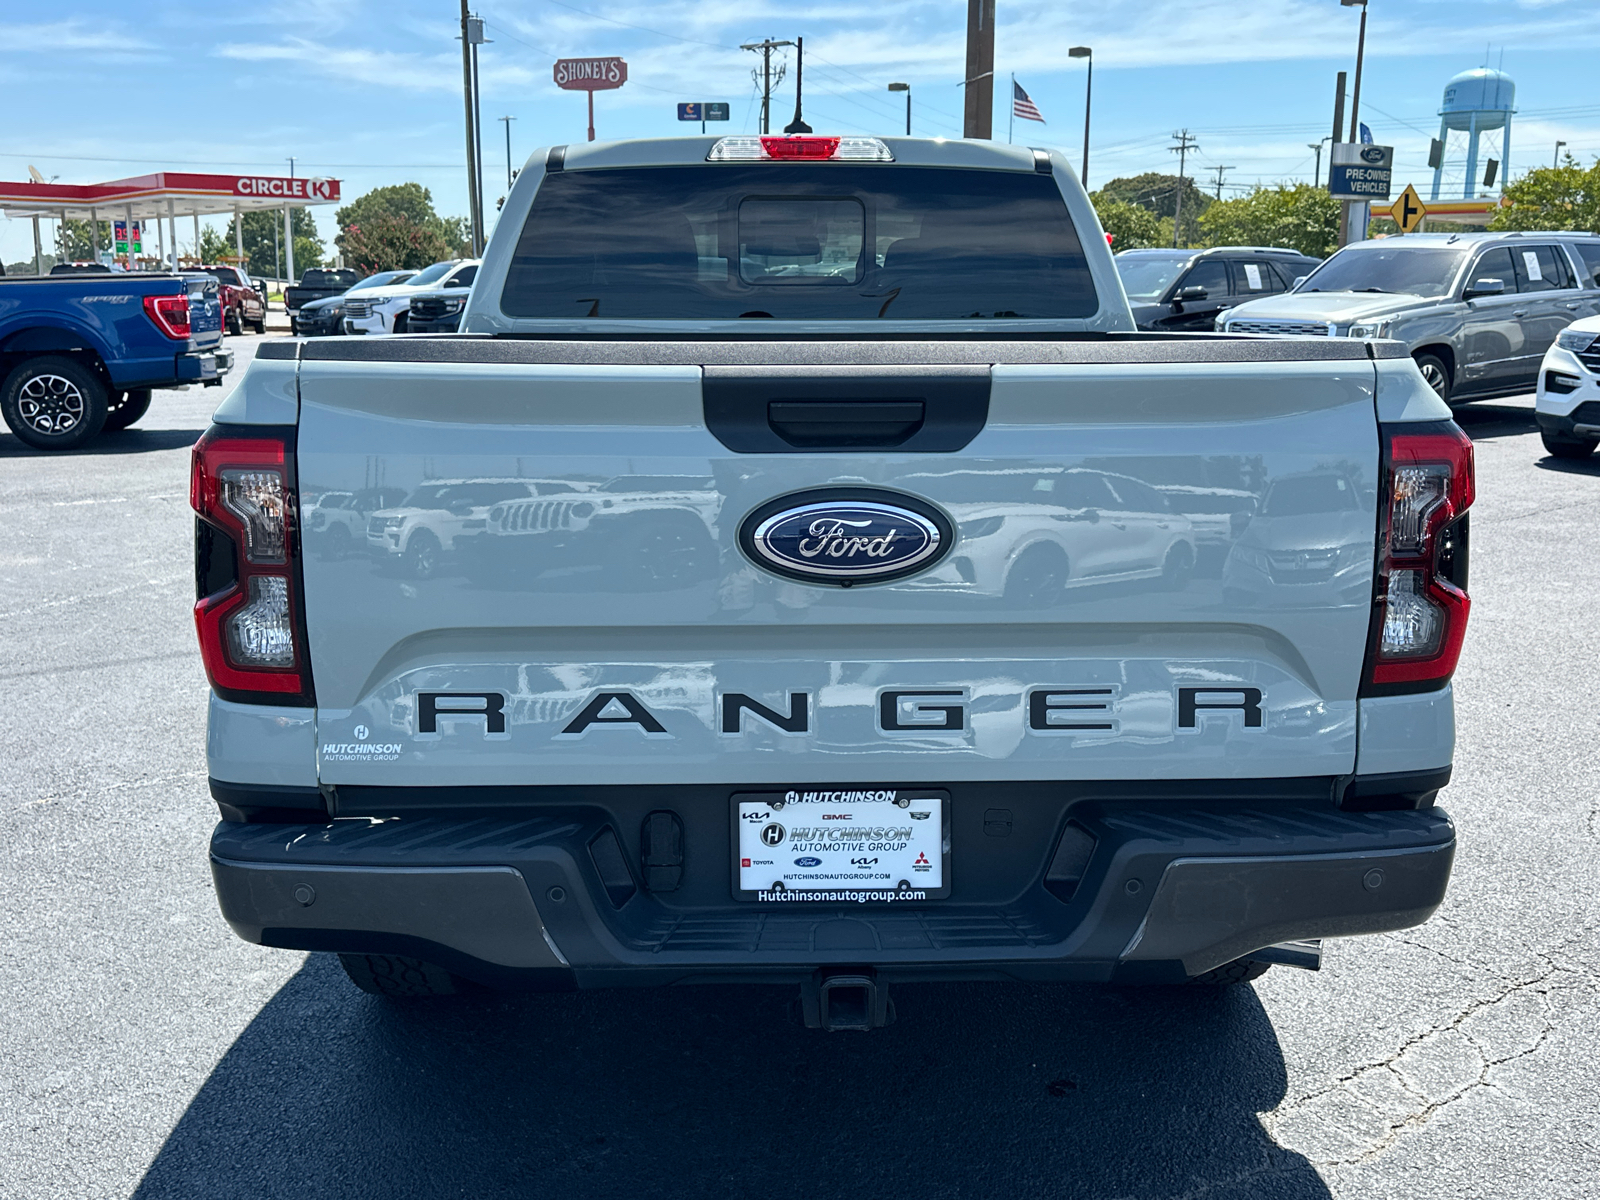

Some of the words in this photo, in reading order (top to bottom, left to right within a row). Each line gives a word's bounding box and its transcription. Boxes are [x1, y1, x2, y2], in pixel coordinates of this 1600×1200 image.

[557, 59, 621, 84] SHONEY'S
[1368, 150, 1383, 160] Ford
[1345, 168, 1391, 181] PRE-OWNED
[237, 178, 303, 196] CIRCLE
[311, 180, 329, 201] K
[1350, 181, 1387, 194] VEHICLES
[798, 517, 897, 558] Ford
[417, 686, 1263, 735] RANGER
[322, 743, 402, 754] HUTCHINSON
[802, 790, 897, 804] HUTCHINSON
[822, 813, 853, 821] GMC
[789, 826, 914, 842] HUTCHINSON
[791, 842, 865, 852] AUTOMOTIVE
[868, 842, 907, 852] GROUP
[798, 856, 817, 868] Ford
[783, 873, 891, 881] HUTCHINSONAUTOGROUP.COM
[758, 889, 927, 903] Hutchinsonautogroup.com
